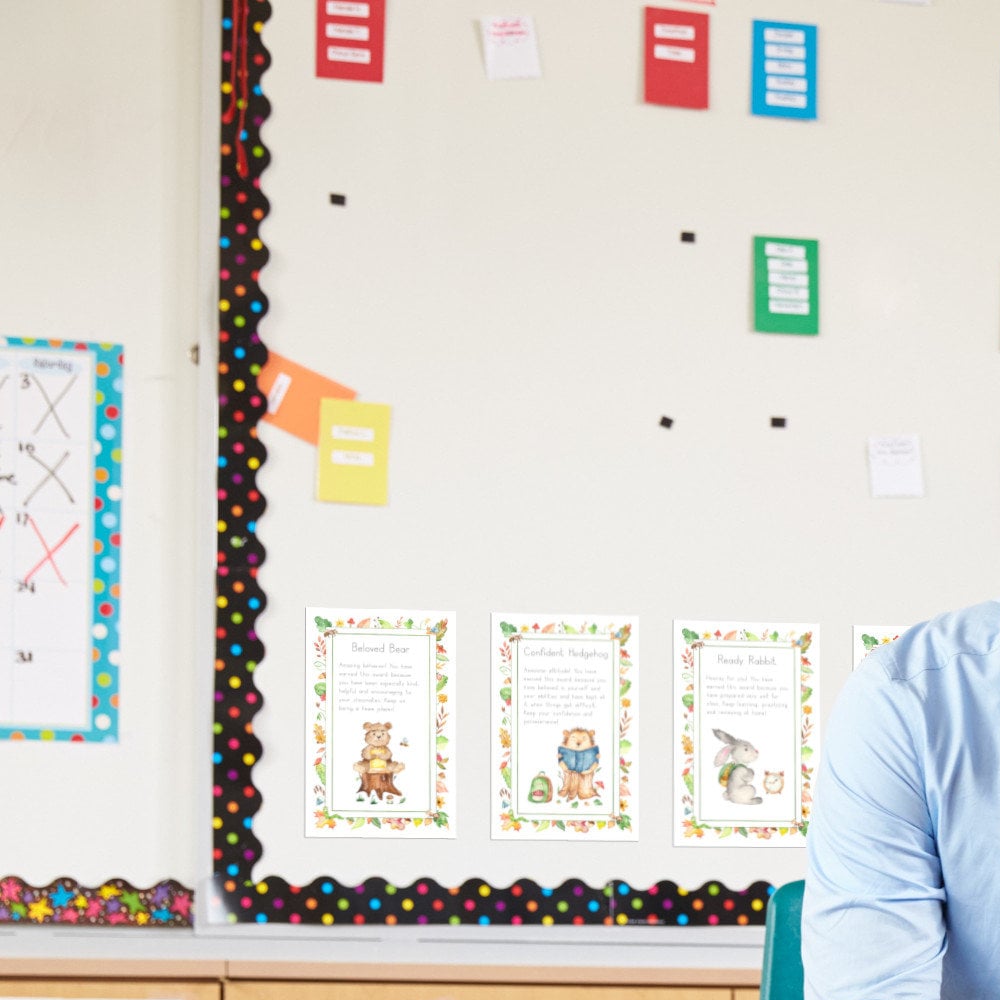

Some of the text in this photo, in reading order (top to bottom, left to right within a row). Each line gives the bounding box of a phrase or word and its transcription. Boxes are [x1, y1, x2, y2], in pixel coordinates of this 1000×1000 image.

[351, 641, 411, 654] Beloved Bear
[523, 646, 609, 661] Confident Hedgehog
[717, 653, 777, 667] Ready Rabbit
